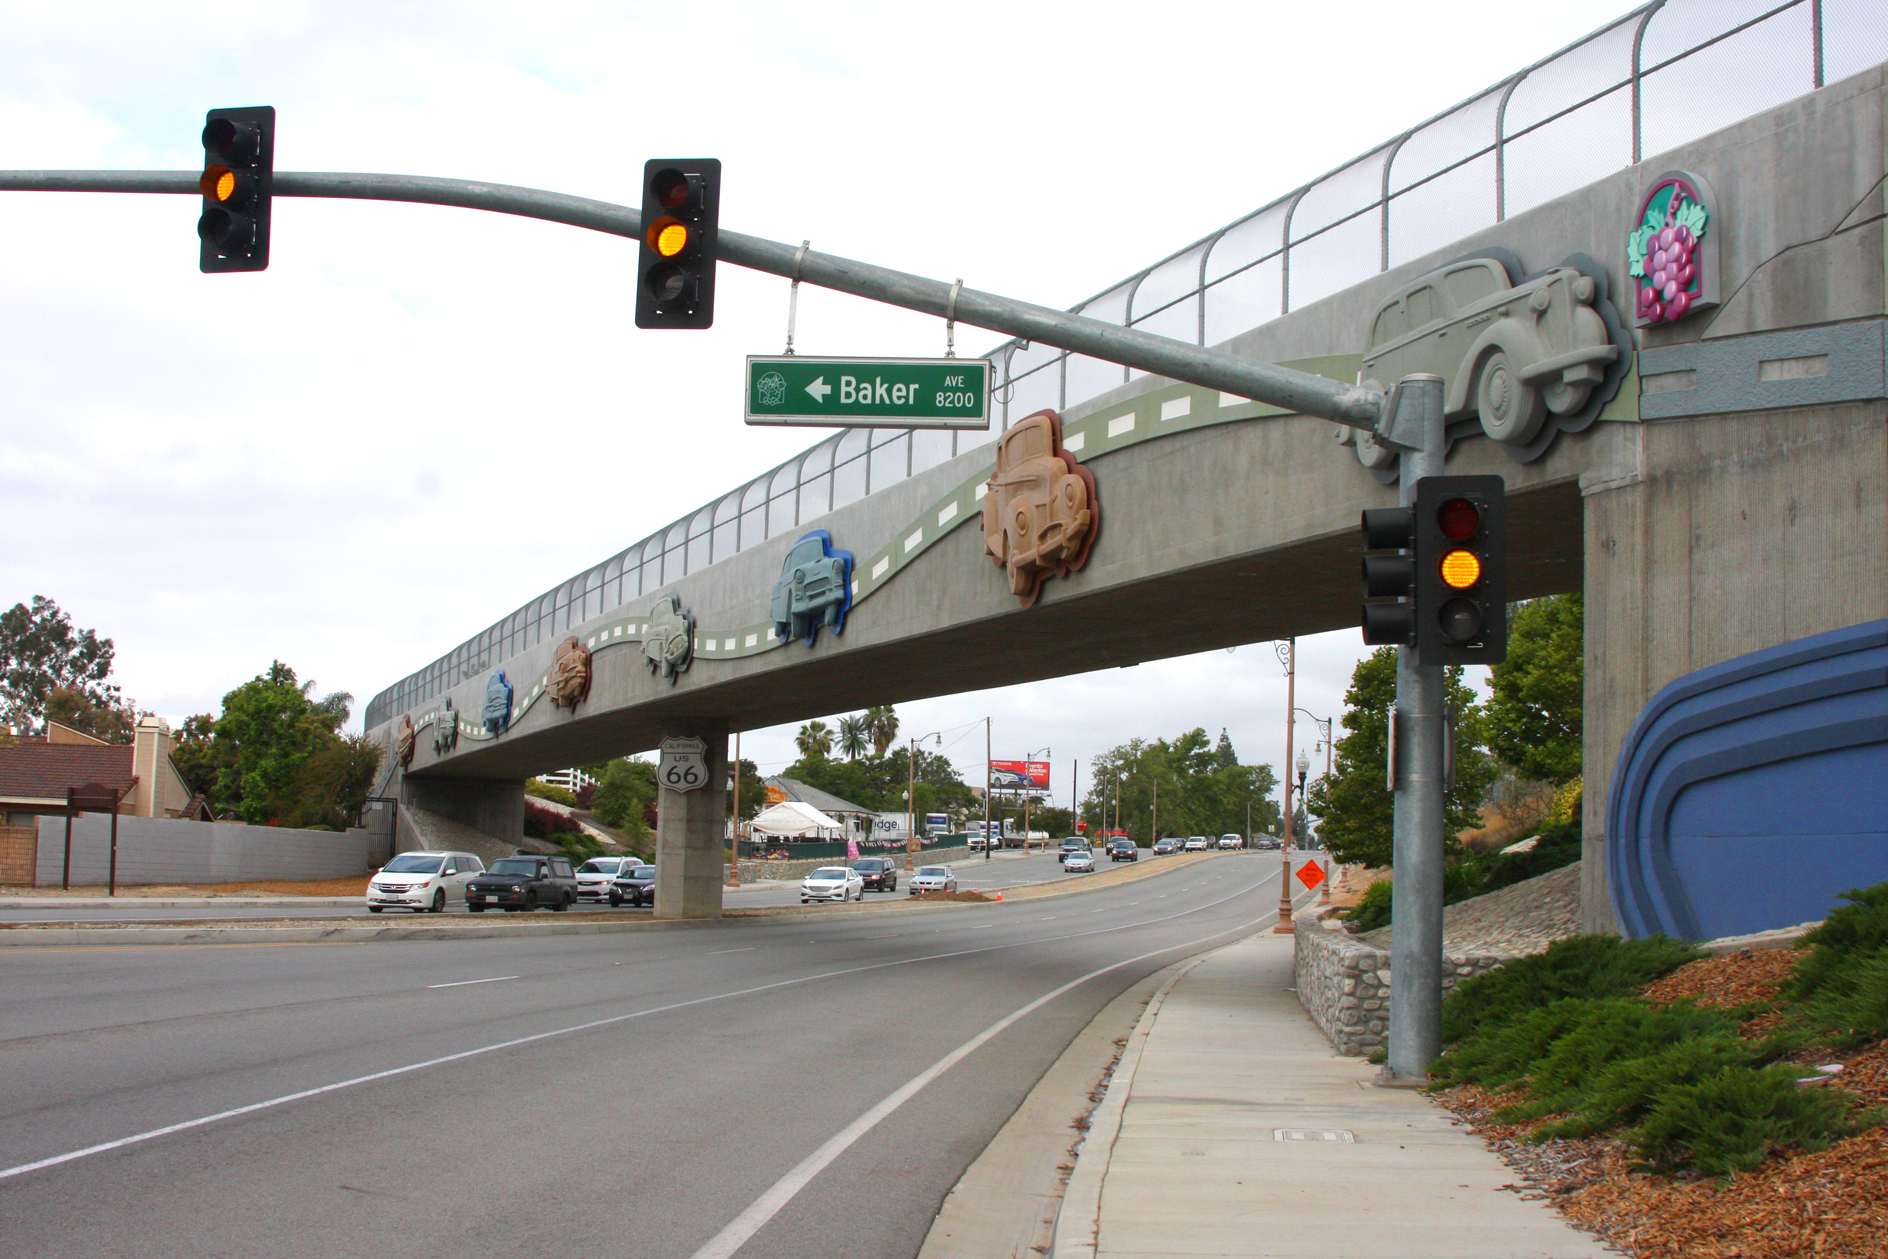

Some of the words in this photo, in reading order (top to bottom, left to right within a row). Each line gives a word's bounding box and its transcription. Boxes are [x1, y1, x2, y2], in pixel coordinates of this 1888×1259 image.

[839, 375, 919, 405] Baker
[944, 376, 965, 388] AVE
[935, 392, 974, 408] 8200
[667, 765, 698, 784] 66
